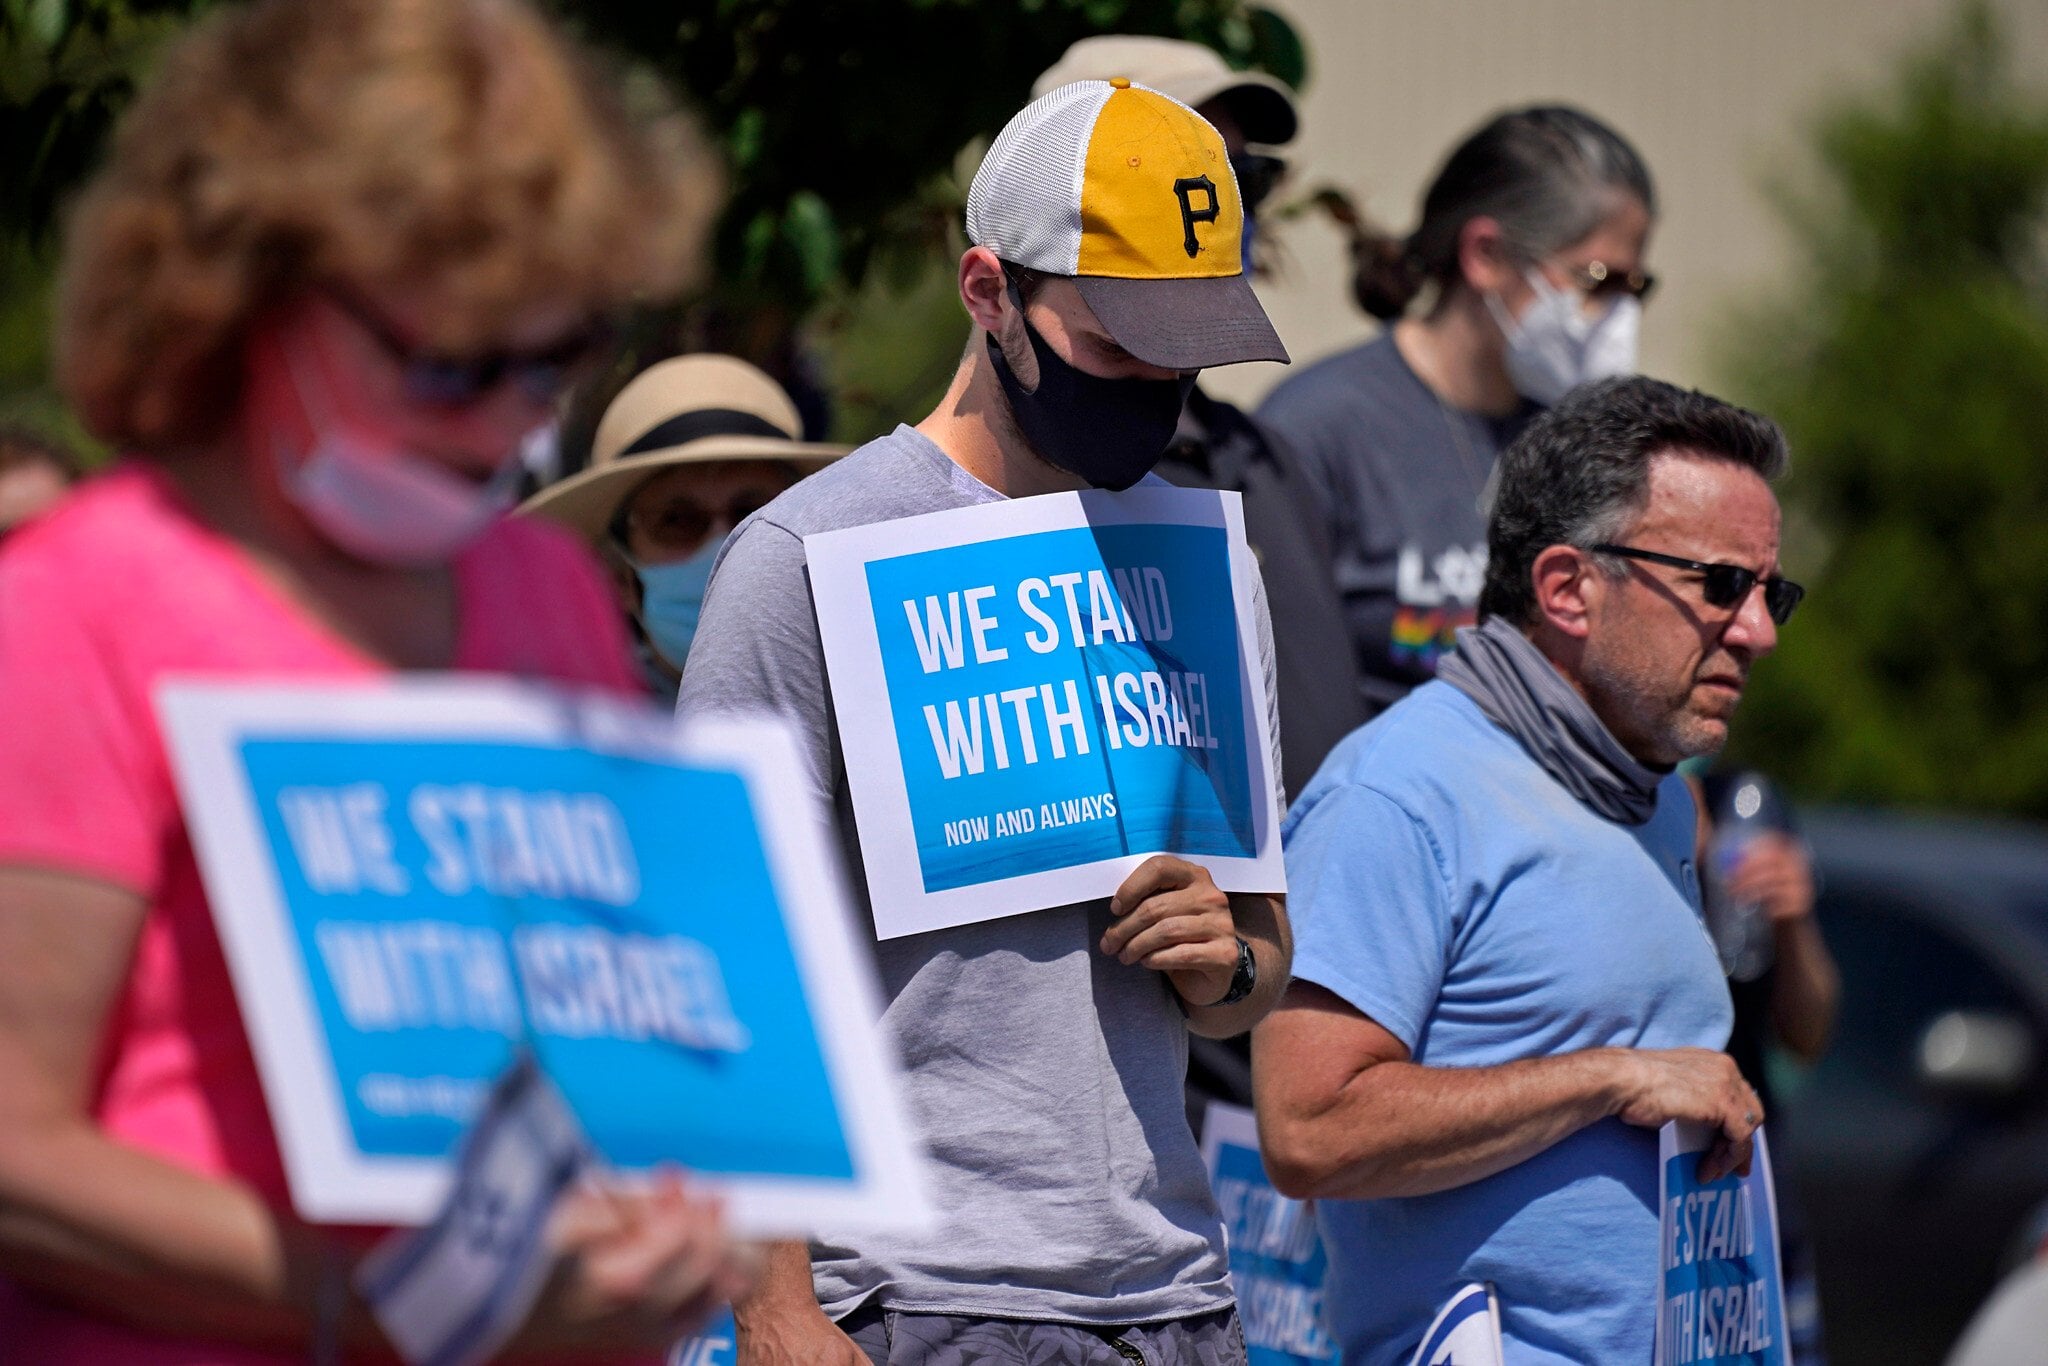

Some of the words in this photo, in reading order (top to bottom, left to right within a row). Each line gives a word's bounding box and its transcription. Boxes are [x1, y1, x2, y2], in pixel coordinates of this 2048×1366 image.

[1173, 174, 1220, 259] P
[902, 585, 1009, 675] WE
[1016, 566, 1174, 655] STAND
[923, 679, 1091, 780] WITH
[1096, 671, 1219, 751] ISRAEL
[277, 784, 409, 896] WE
[407, 783, 641, 905] STAND
[943, 813, 990, 848] NOW
[995, 807, 1037, 838] AND
[1040, 792, 1118, 832] ALWAYS
[314, 919, 522, 1039] WITH
[511, 922, 753, 1053] ISRAEL
[1697, 1278, 1773, 1360] ISRAEL
